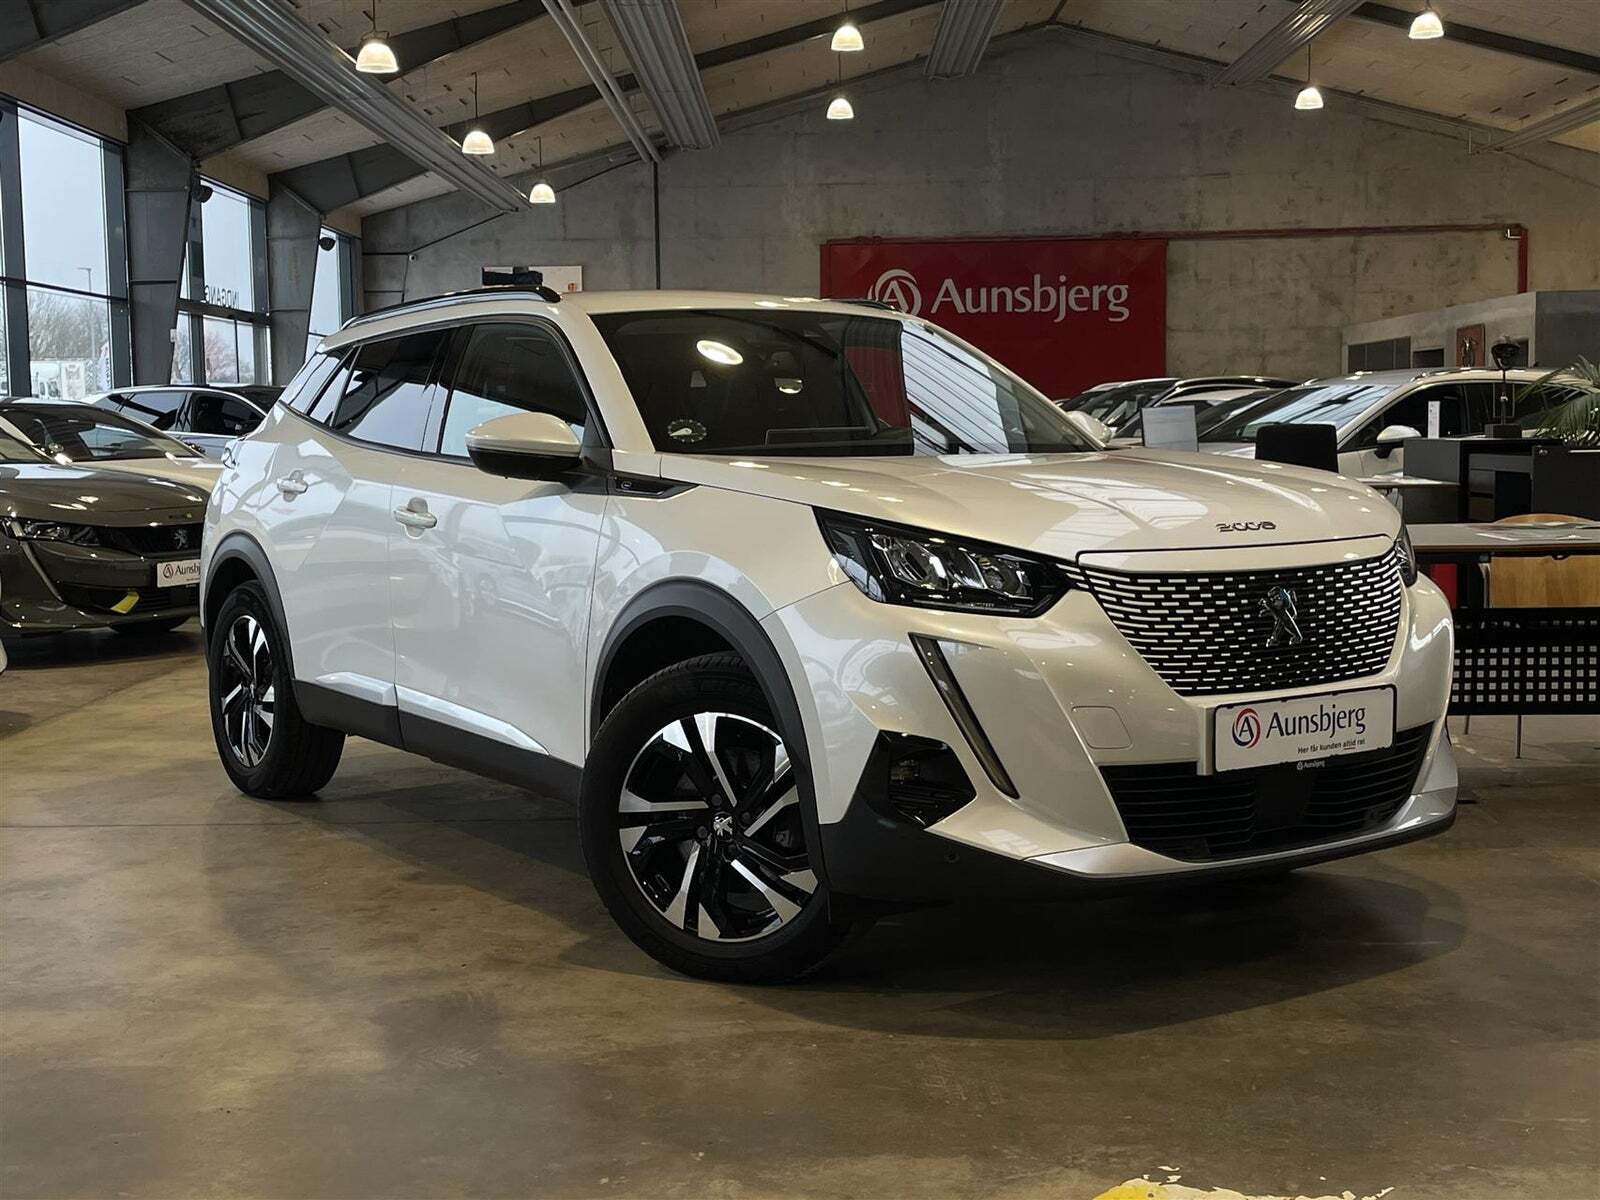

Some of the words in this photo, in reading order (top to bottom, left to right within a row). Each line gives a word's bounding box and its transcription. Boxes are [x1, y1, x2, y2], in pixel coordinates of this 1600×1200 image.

[931, 274, 1129, 322] Aunsbjerg
[1215, 521, 1276, 533] 2008
[175, 562, 201, 576] Aunsbj
[1266, 704, 1366, 738] Aunsbjerg
[1297, 746, 1309, 754] Her
